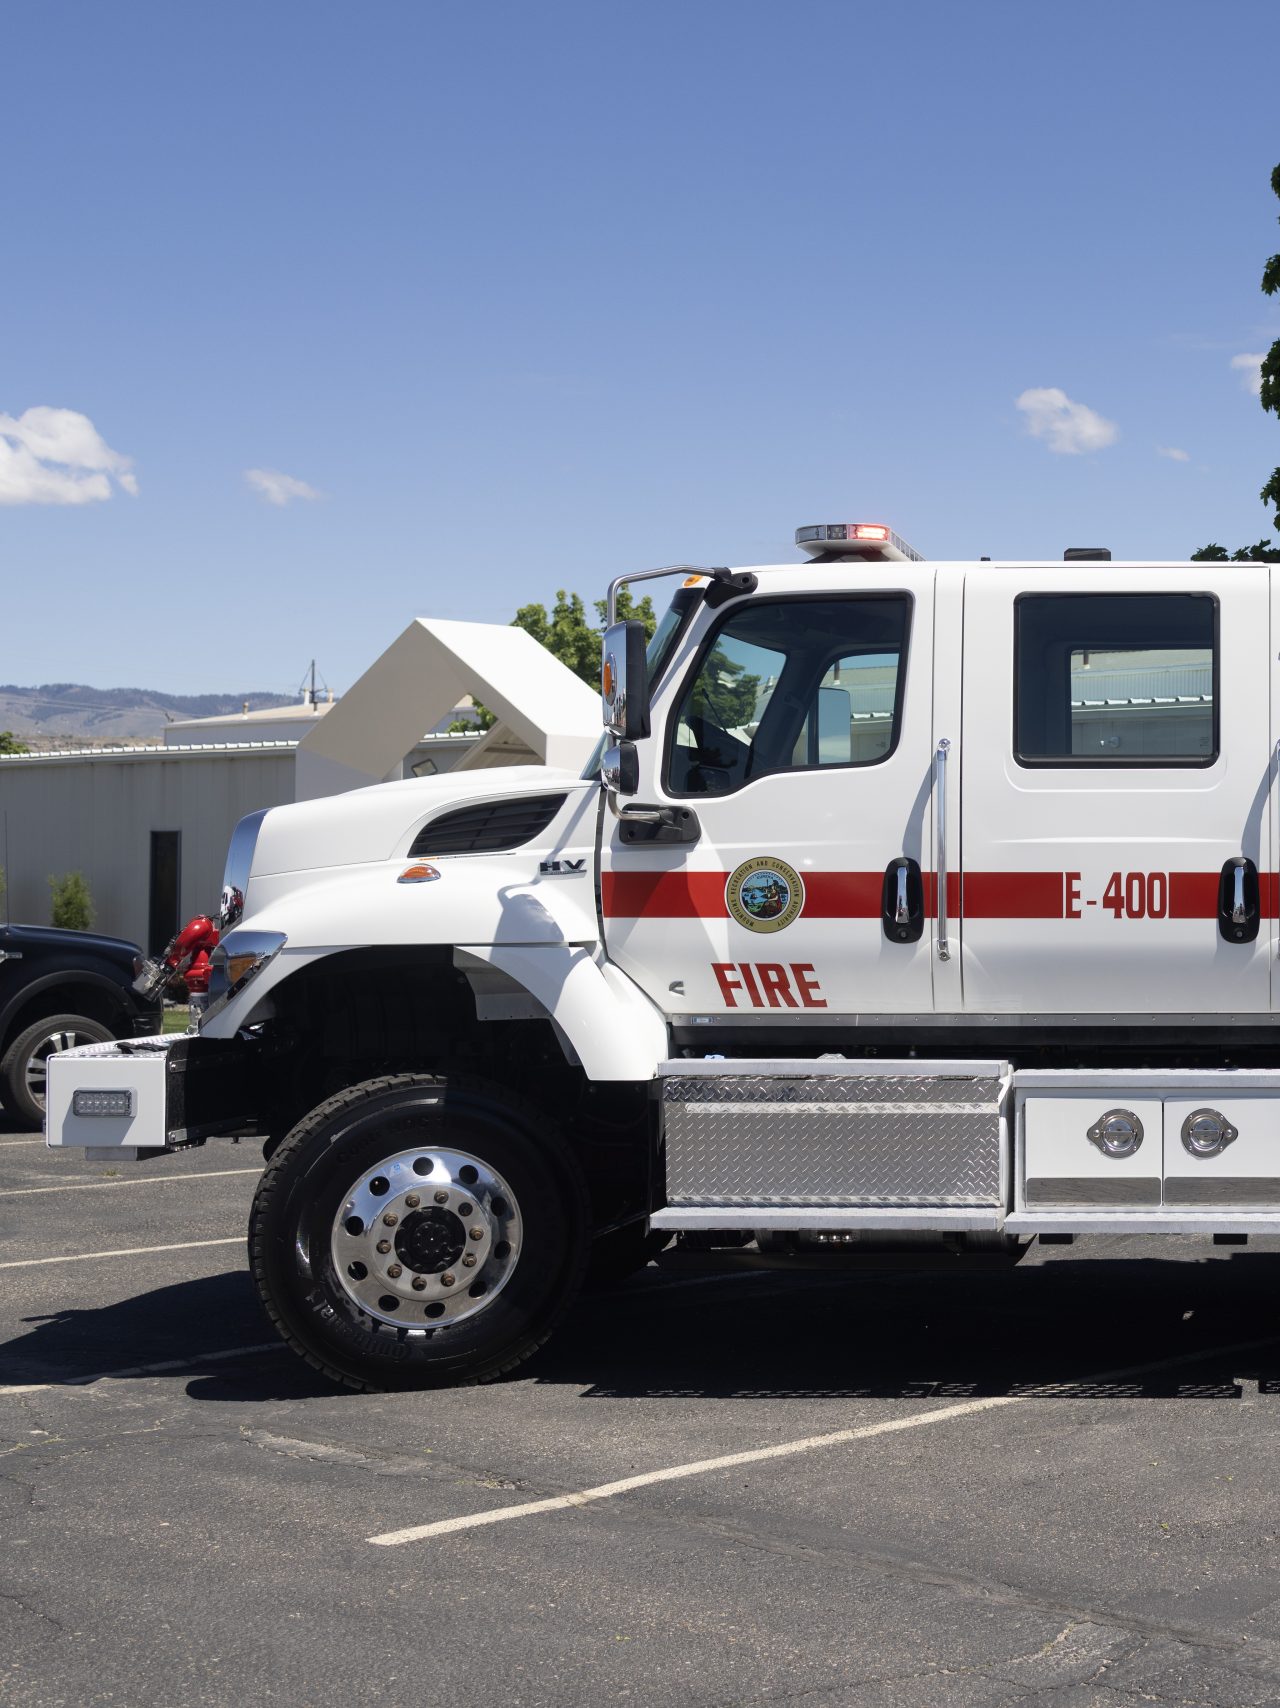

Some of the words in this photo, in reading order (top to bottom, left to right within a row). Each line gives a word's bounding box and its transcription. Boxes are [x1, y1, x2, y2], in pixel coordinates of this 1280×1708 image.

[540, 859, 586, 872] HV
[730, 863, 753, 895] RECREATION
[772, 861, 800, 897] CONSERVATION
[1065, 872, 1167, 919] E-400
[731, 898, 755, 928] MOUNTAINS
[777, 901, 799, 927] AUTHORITY
[711, 963, 828, 1008] FIRE
